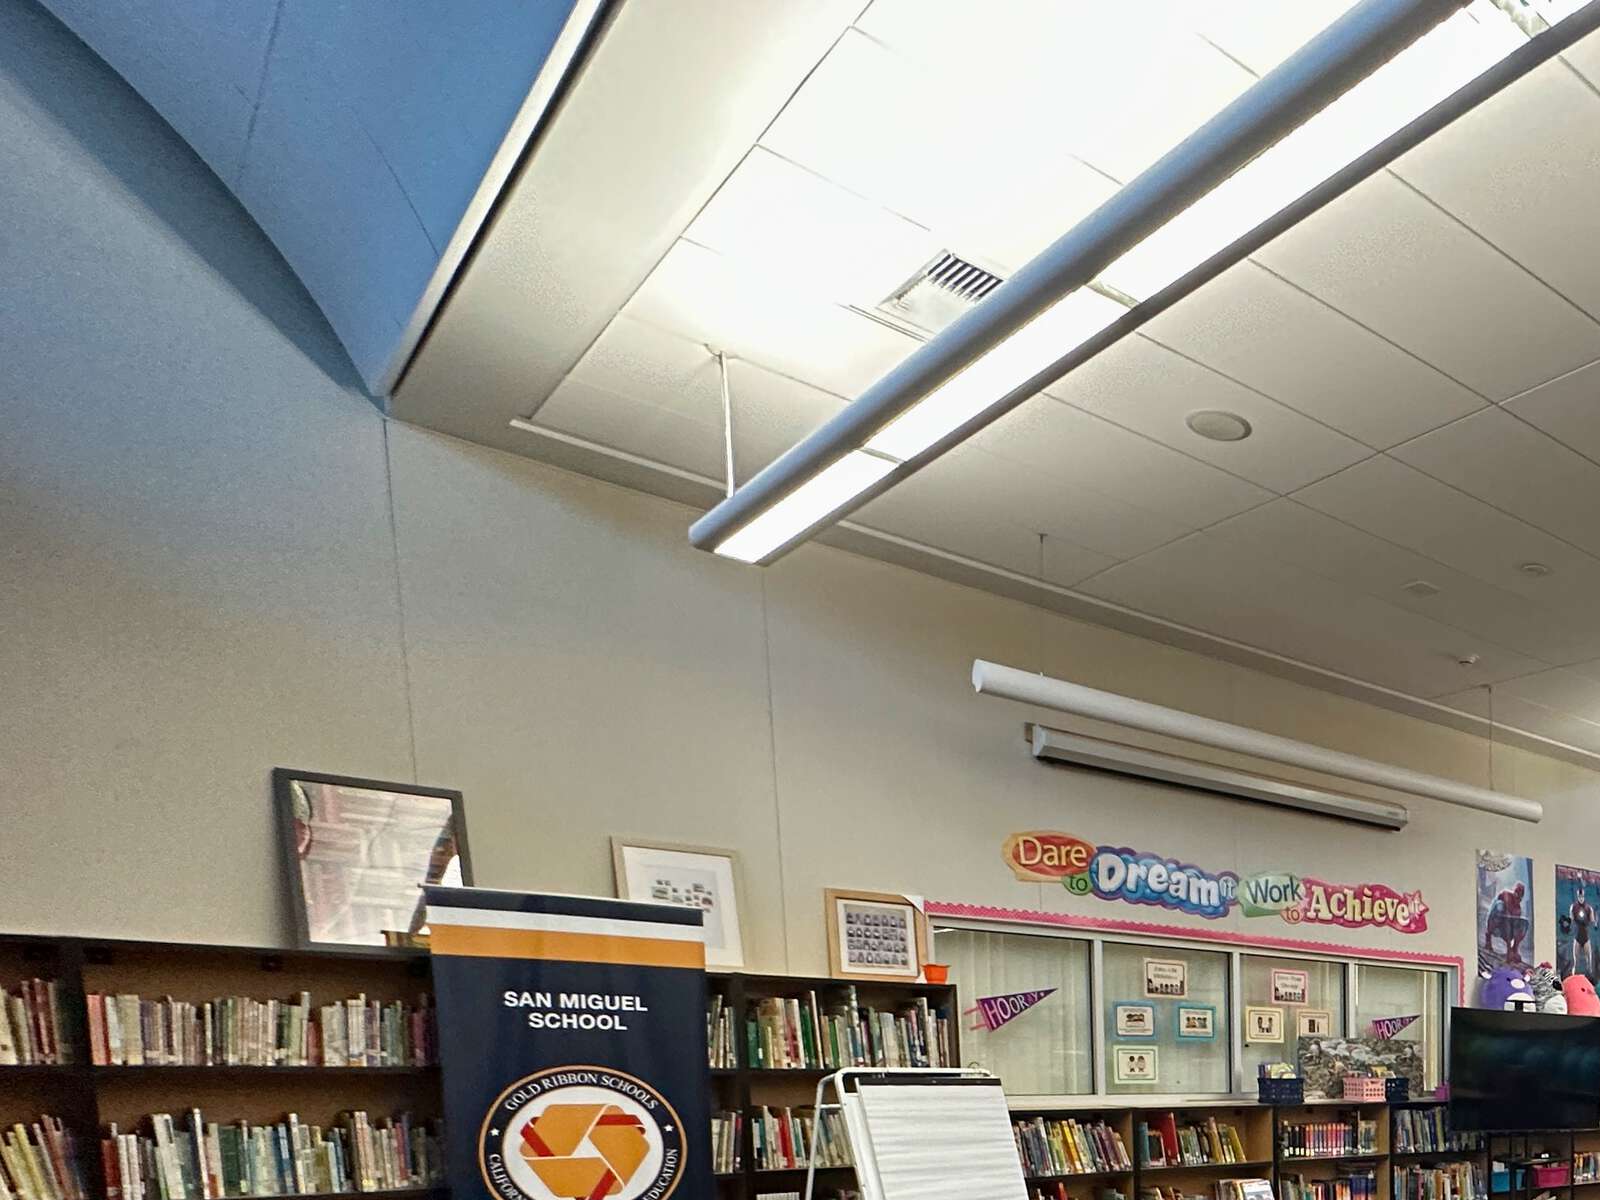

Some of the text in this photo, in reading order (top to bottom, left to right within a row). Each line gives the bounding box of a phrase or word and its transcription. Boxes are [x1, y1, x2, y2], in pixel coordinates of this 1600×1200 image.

[1018, 836, 1088, 867] Dare
[1069, 875, 1088, 891] to
[1097, 852, 1221, 907] Dream
[1247, 876, 1302, 904] Work
[1285, 906, 1300, 922] to
[1306, 885, 1410, 926] Achieve
[503, 990, 648, 1012] SAN MIGUEL
[528, 1012, 628, 1031] SCHOOL
[505, 1073, 659, 1111] GOLD RIBBON SCHOOLS
